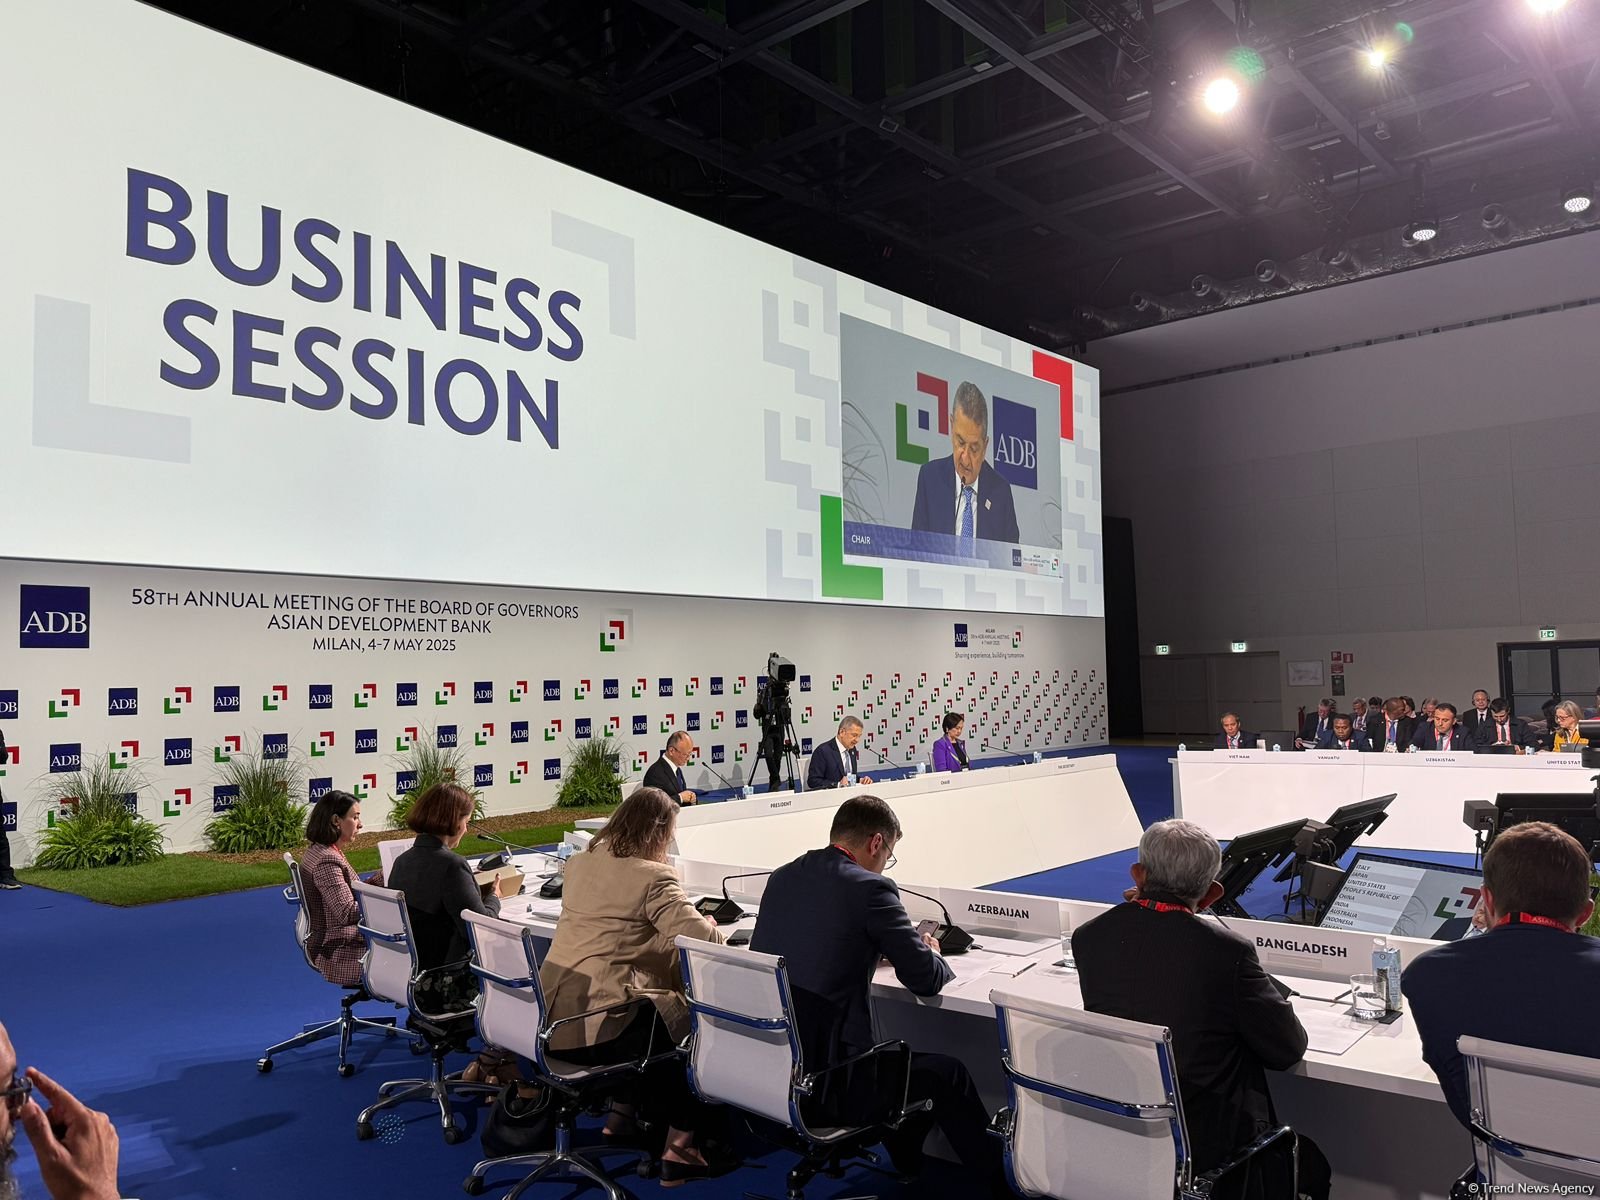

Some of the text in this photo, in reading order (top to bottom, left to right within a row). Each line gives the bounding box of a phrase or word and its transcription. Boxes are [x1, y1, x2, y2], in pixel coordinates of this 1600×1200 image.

[126, 167, 584, 361] BUSINESS
[160, 298, 559, 449] SESSION
[995, 433, 1036, 469] ADB
[852, 534, 870, 544] CHAIR
[131, 588, 579, 619] 58TH ANNUAL MEETING OF THE BOARD OF GOVERNORS
[22, 611, 88, 634] ADB
[267, 614, 492, 634] ASIAN DEVELOPMENT BANK
[956, 633, 968, 642] ADB
[313, 638, 456, 653] MILAN, 4-7 MAY 2025
[474, 688, 493, 698] ADB
[544, 686, 560, 696] ADB
[604, 686, 618, 694] ADB
[659, 685, 673, 694] ADB
[710, 684, 723, 692] ADB
[310, 693, 332, 704] ADB
[398, 690, 418, 700] ADB
[110, 698, 137, 710] ADB
[214, 696, 240, 706] ADB
[0, 702, 17, 712] DB
[632, 722, 647, 731] ADB
[687, 720, 700, 728] ADB
[511, 730, 528, 738] ADB
[576, 726, 591, 734] ADB
[356, 738, 378, 748] ADB
[438, 734, 457, 744] ADB
[164, 748, 192, 760] ADB
[264, 744, 288, 754] ADB
[52, 755, 80, 766] ADB
[712, 752, 724, 760] ADB
[544, 767, 560, 776] ADB
[475, 772, 493, 782] ADB
[397, 780, 417, 790] ADB
[1343, 886, 1366, 894] PEOPLE'S
[1367, 891, 1391, 899] REPUBLIC
[968, 903, 1030, 920] AZERBAIJAN
[1330, 909, 1358, 918] AUSTRALIA
[1325, 917, 1354, 926] INDONESIA
[1532, 916, 1555, 926] ASIAN
[1256, 936, 1348, 958] BANGLADESH
